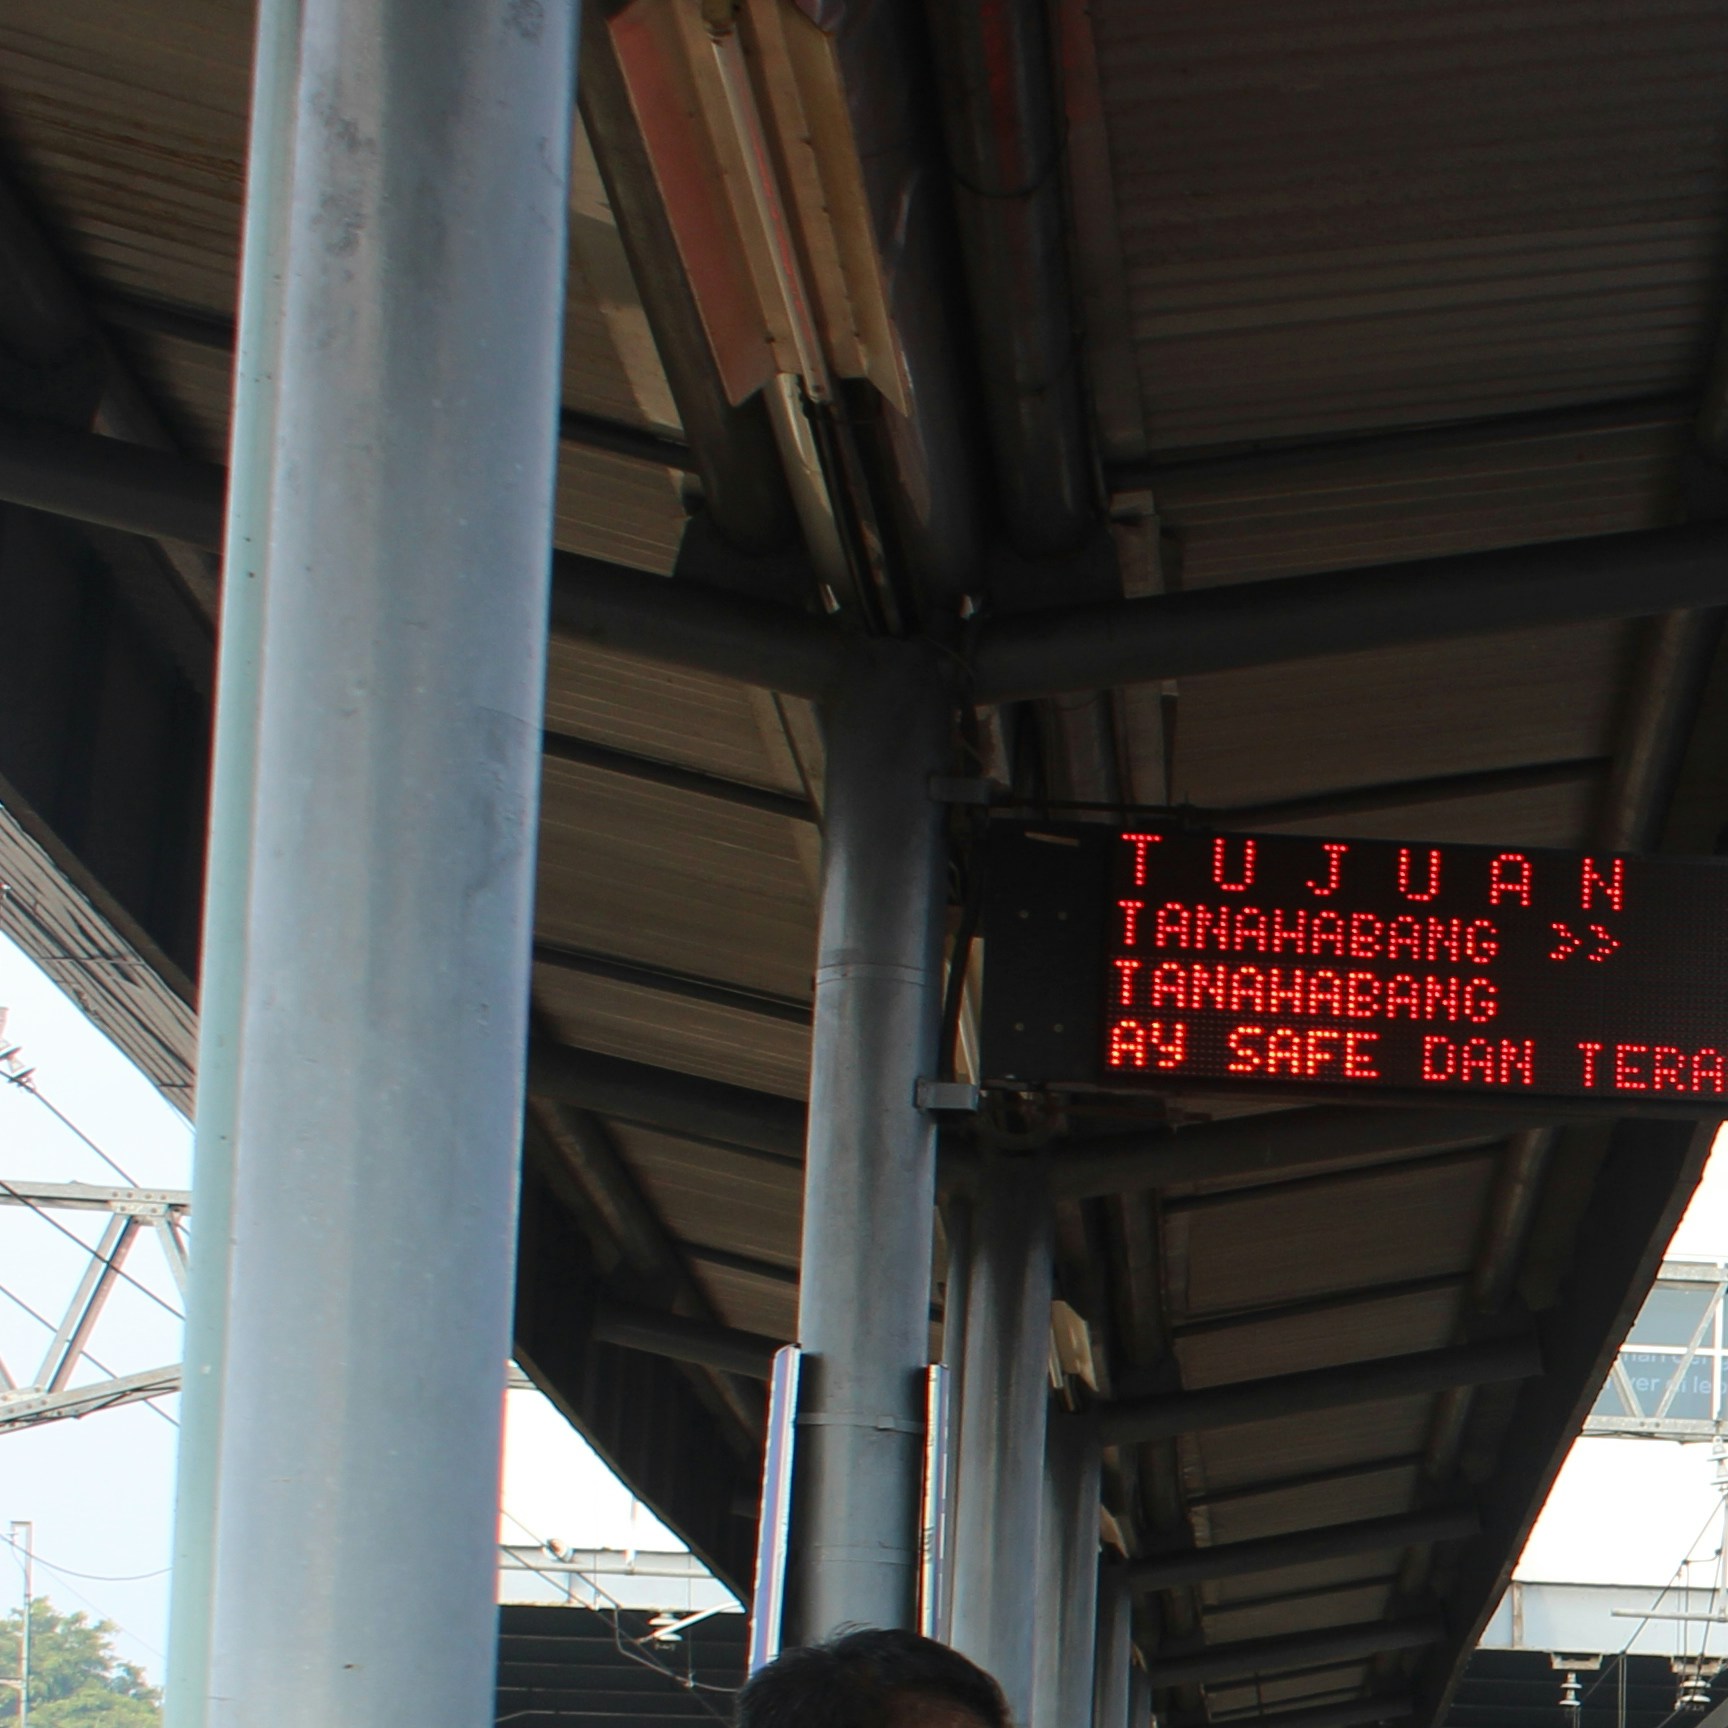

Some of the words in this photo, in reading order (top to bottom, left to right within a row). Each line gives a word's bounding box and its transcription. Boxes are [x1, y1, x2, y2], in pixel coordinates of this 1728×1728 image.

[1118, 900, 1499, 964] TANAHABANG
[1113, 959, 1498, 1023] TANAHABANG
[1227, 1026, 1379, 1078] SAFE
[1422, 1035, 1534, 1085] DAN
